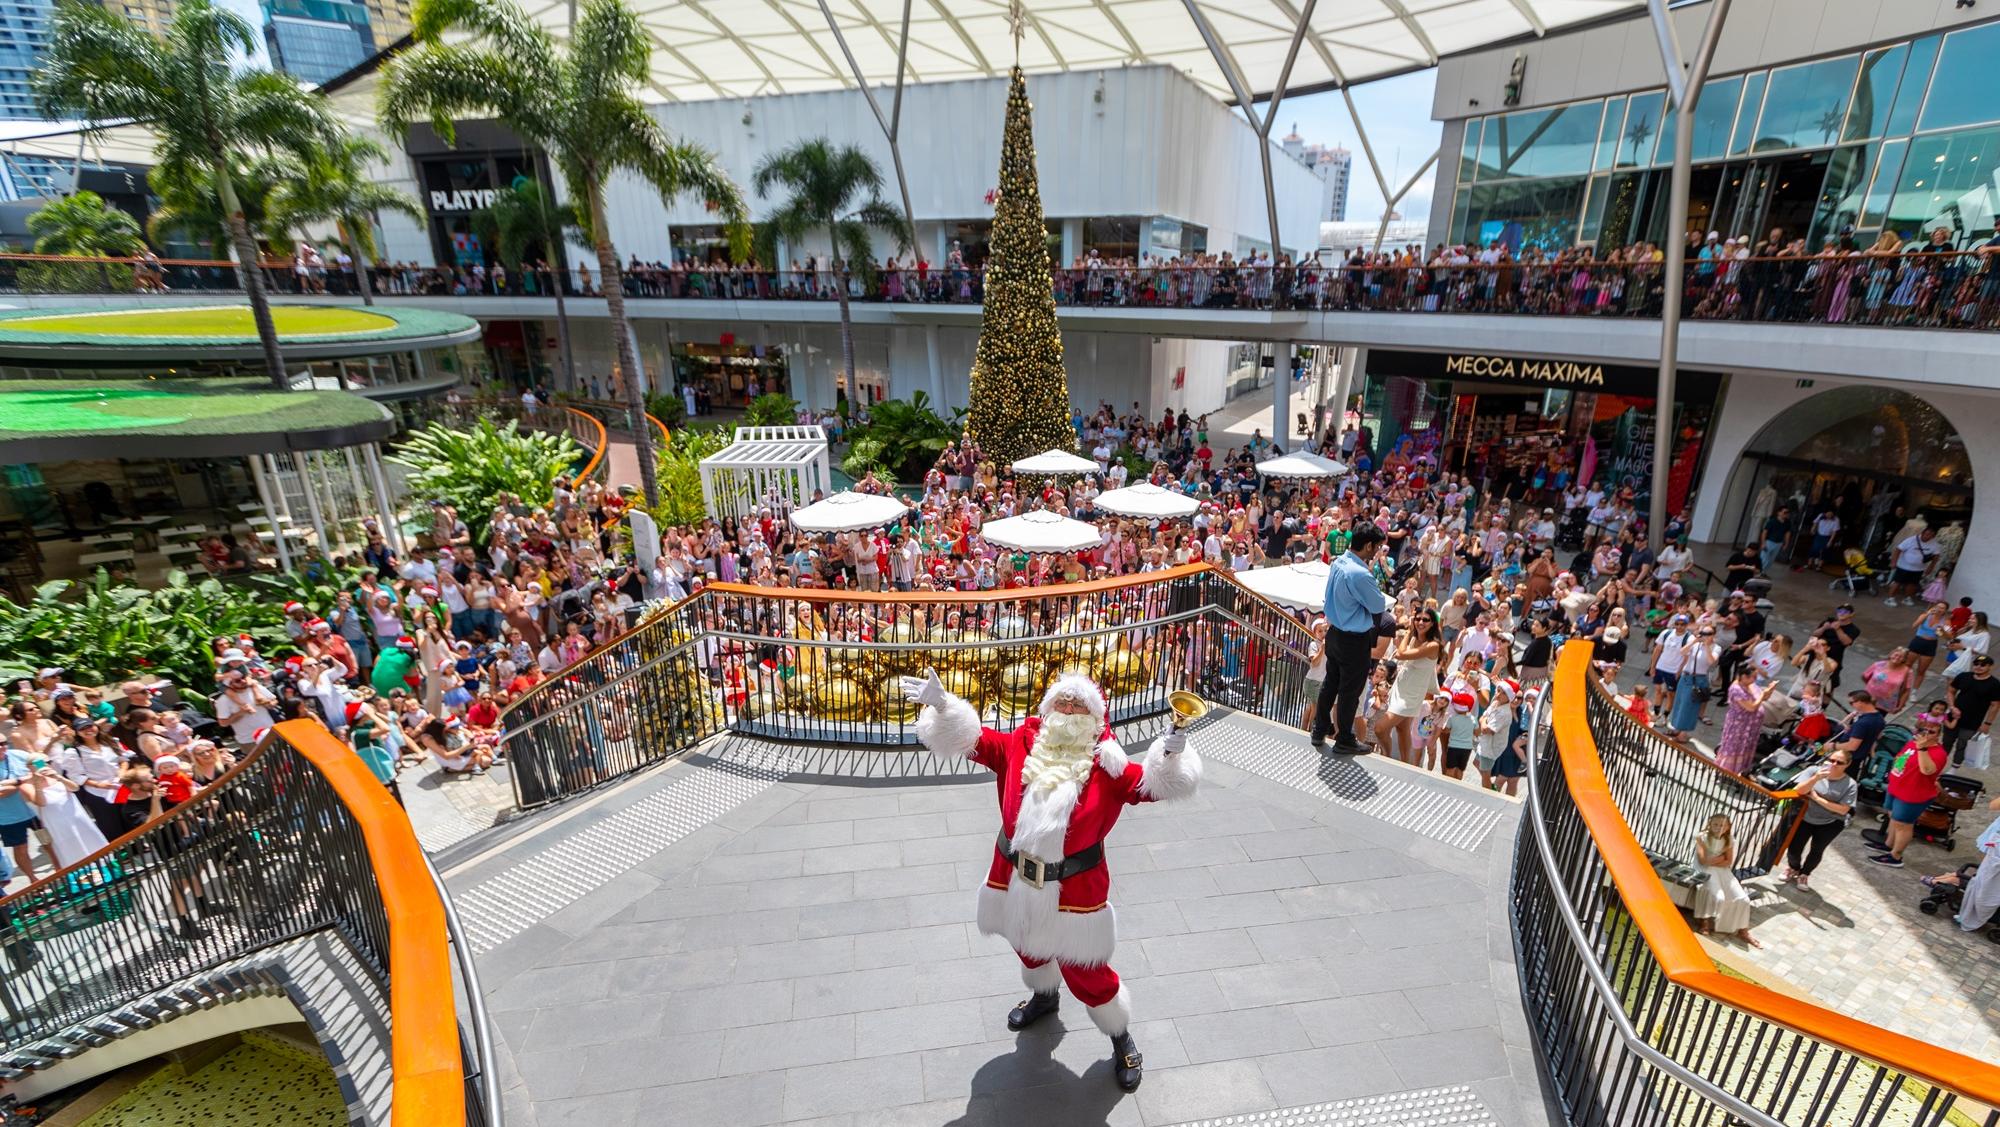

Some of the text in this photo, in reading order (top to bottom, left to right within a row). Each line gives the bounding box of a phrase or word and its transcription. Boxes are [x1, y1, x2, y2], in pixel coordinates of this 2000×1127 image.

[430, 188, 520, 210] PLATYP
[1446, 356, 1604, 386] MECCA MAXIMA
[1627, 424, 1656, 440] GIF
[1626, 440, 1654, 458] THE
[1614, 455, 1655, 476] MAGIC
[1622, 474, 1643, 490] OF
